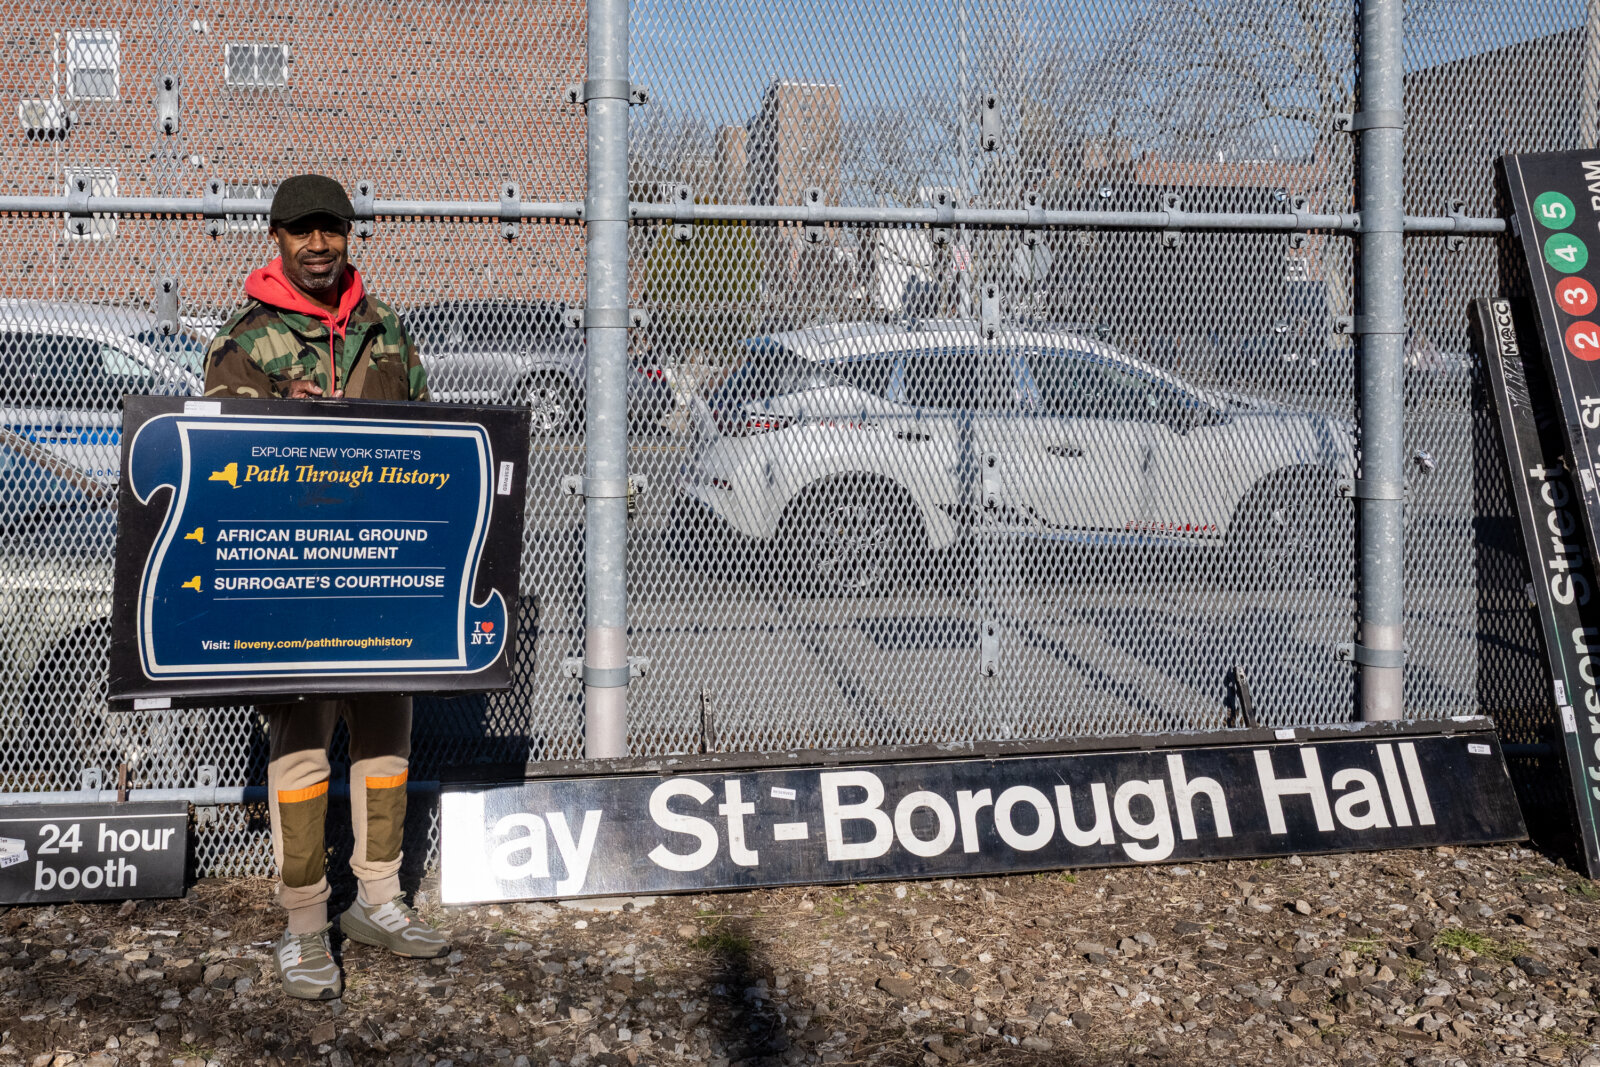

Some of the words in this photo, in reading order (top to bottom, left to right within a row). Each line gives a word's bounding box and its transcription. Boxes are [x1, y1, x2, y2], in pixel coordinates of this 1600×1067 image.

[1542, 202, 1566, 219] 5
[1554, 244, 1578, 262] 4
[1564, 287, 1588, 305] 3
[1574, 331, 1600, 349] 2
[252, 446, 307, 458] EXPLORE
[310, 447, 338, 458] NEW
[340, 447, 372, 459] YORK
[375, 448, 421, 460] STATE'S
[244, 464, 290, 482] Path
[295, 464, 374, 488] Through
[378, 466, 450, 490] History
[216, 529, 290, 542] AFRICAN
[295, 529, 354, 541] BURIAL
[358, 529, 428, 541] GROUND
[1530, 464, 1591, 606] Street
[216, 547, 299, 560] NATIONAL
[303, 547, 399, 560] MONUMENT
[214, 576, 331, 590] SURROGATE'S
[334, 575, 445, 588] COURTHOUSE
[474, 621, 481, 633] I
[202, 640, 231, 650] Visit:
[233, 637, 413, 651] iloveny.com/paththroughhistory
[471, 633, 496, 645] NY
[455, 793, 602, 895] ay
[1253, 742, 1436, 835] Hall
[37, 823, 83, 855] 24
[98, 823, 175, 852] hour
[34, 857, 138, 891] booth
